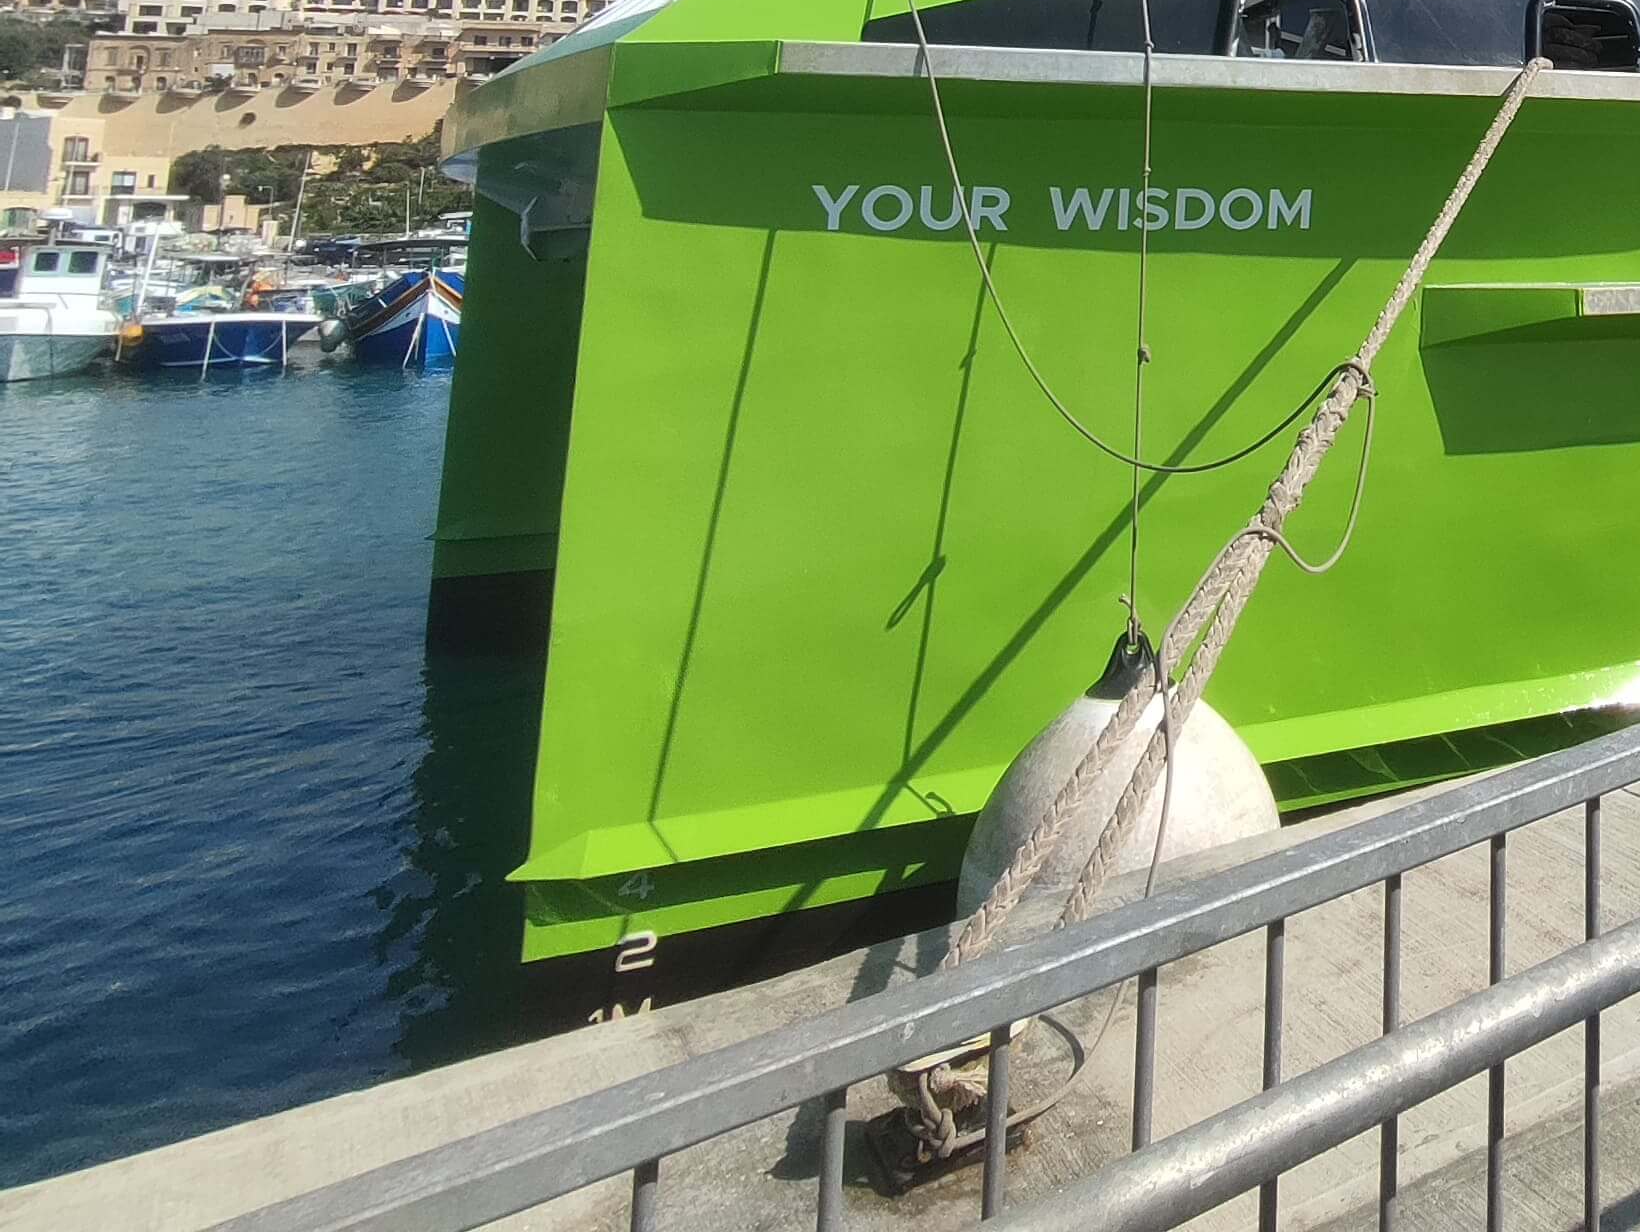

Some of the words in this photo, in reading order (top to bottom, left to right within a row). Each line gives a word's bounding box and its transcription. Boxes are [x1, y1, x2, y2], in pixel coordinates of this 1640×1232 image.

[812, 184, 1011, 231] YOUR
[1048, 186, 1313, 231] WISDOM
[615, 930, 657, 972] 2
